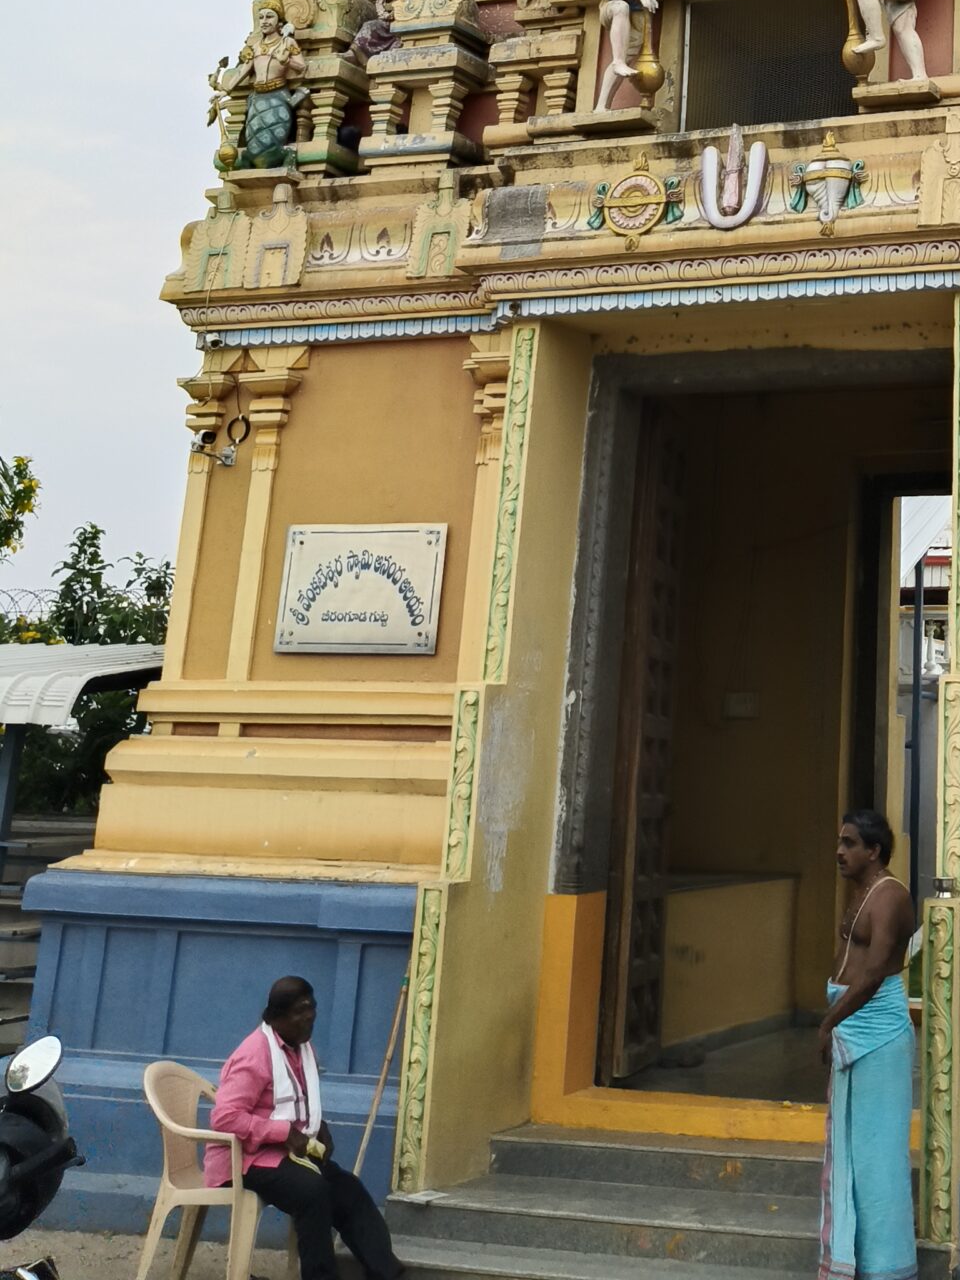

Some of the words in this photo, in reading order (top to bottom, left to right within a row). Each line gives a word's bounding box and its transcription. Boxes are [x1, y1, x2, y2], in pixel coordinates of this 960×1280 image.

[289, 607, 310, 626] శ్రీ
[346, 549, 373, 580] స్వామి
[368, 610, 389, 627] గుట్ట
